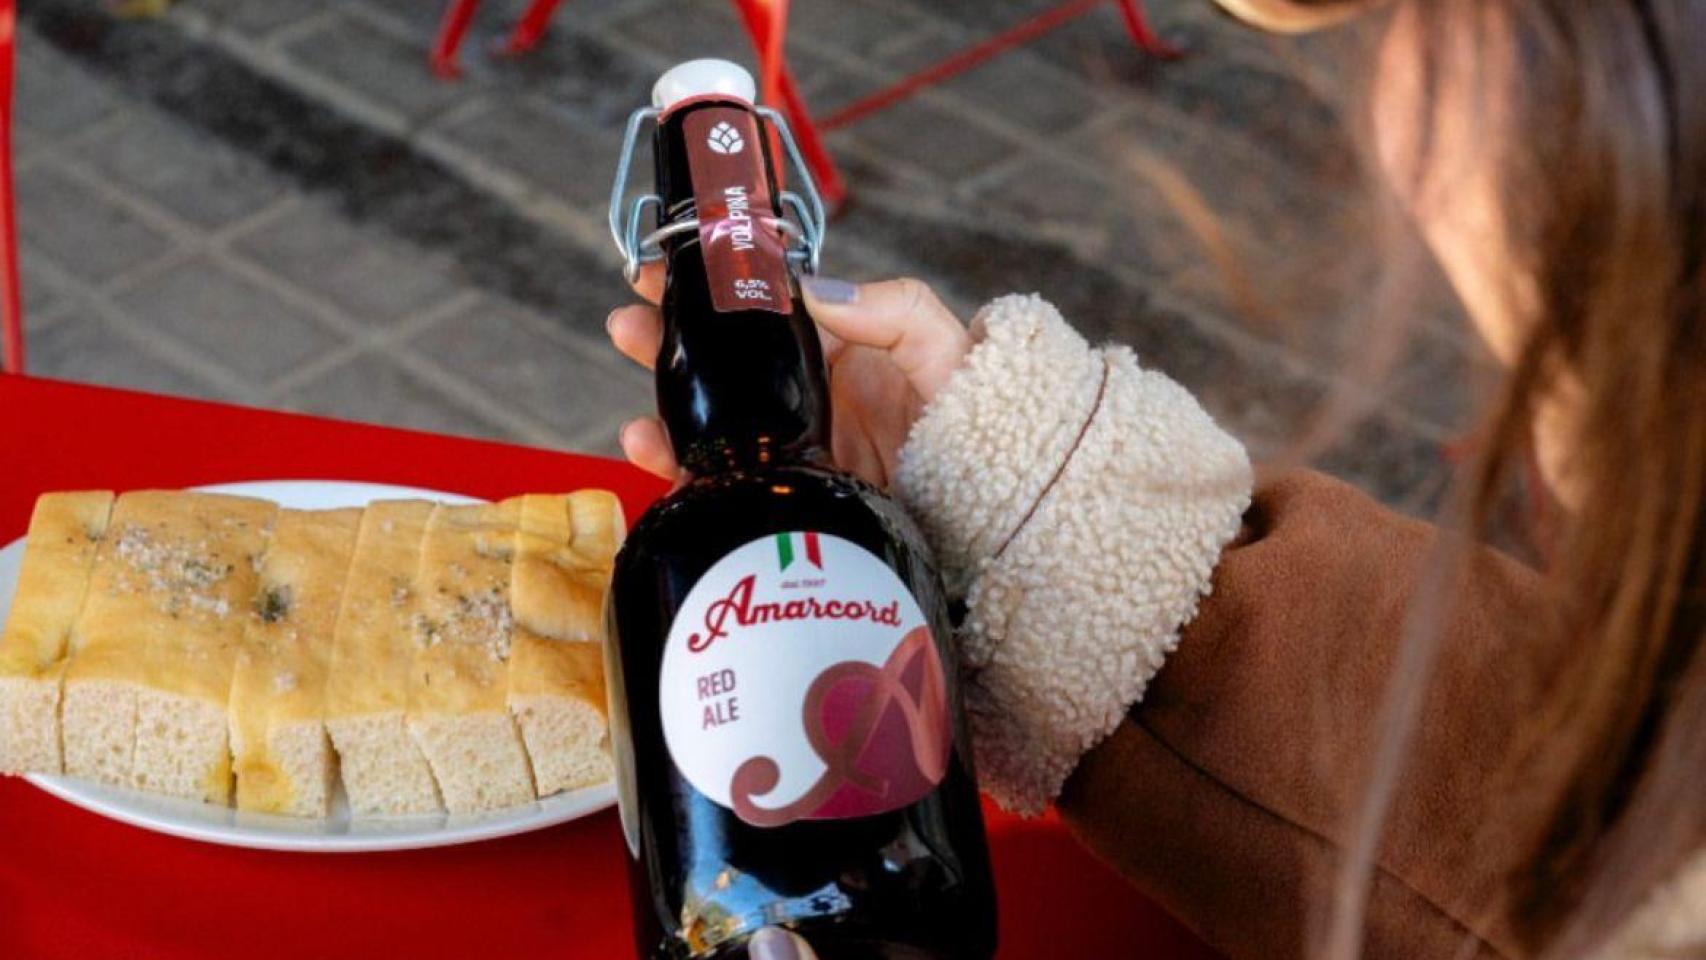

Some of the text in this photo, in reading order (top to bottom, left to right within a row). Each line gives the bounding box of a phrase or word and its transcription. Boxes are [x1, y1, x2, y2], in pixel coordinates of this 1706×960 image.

[724, 186, 754, 250] VOLPINA
[687, 574, 901, 653] Amarcord
[697, 668, 736, 701] RED
[702, 697, 740, 730] ALE
